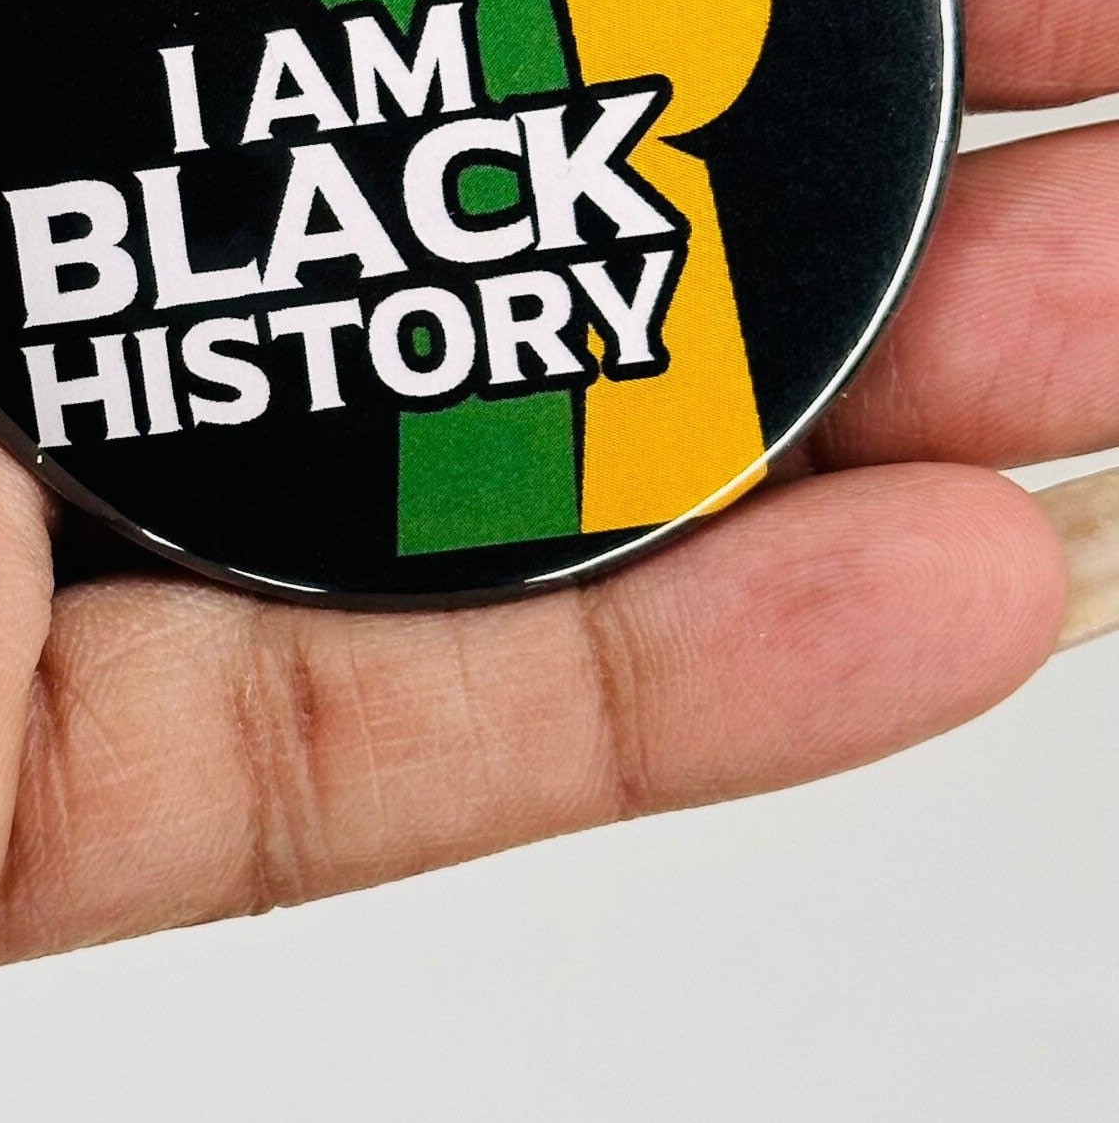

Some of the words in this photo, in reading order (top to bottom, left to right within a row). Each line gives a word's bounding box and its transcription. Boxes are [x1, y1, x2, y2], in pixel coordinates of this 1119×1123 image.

[159, 45, 210, 153] I
[241, 2, 476, 145] AM
[1, 90, 676, 328] BLACK
[20, 250, 673, 449] HISTORY
